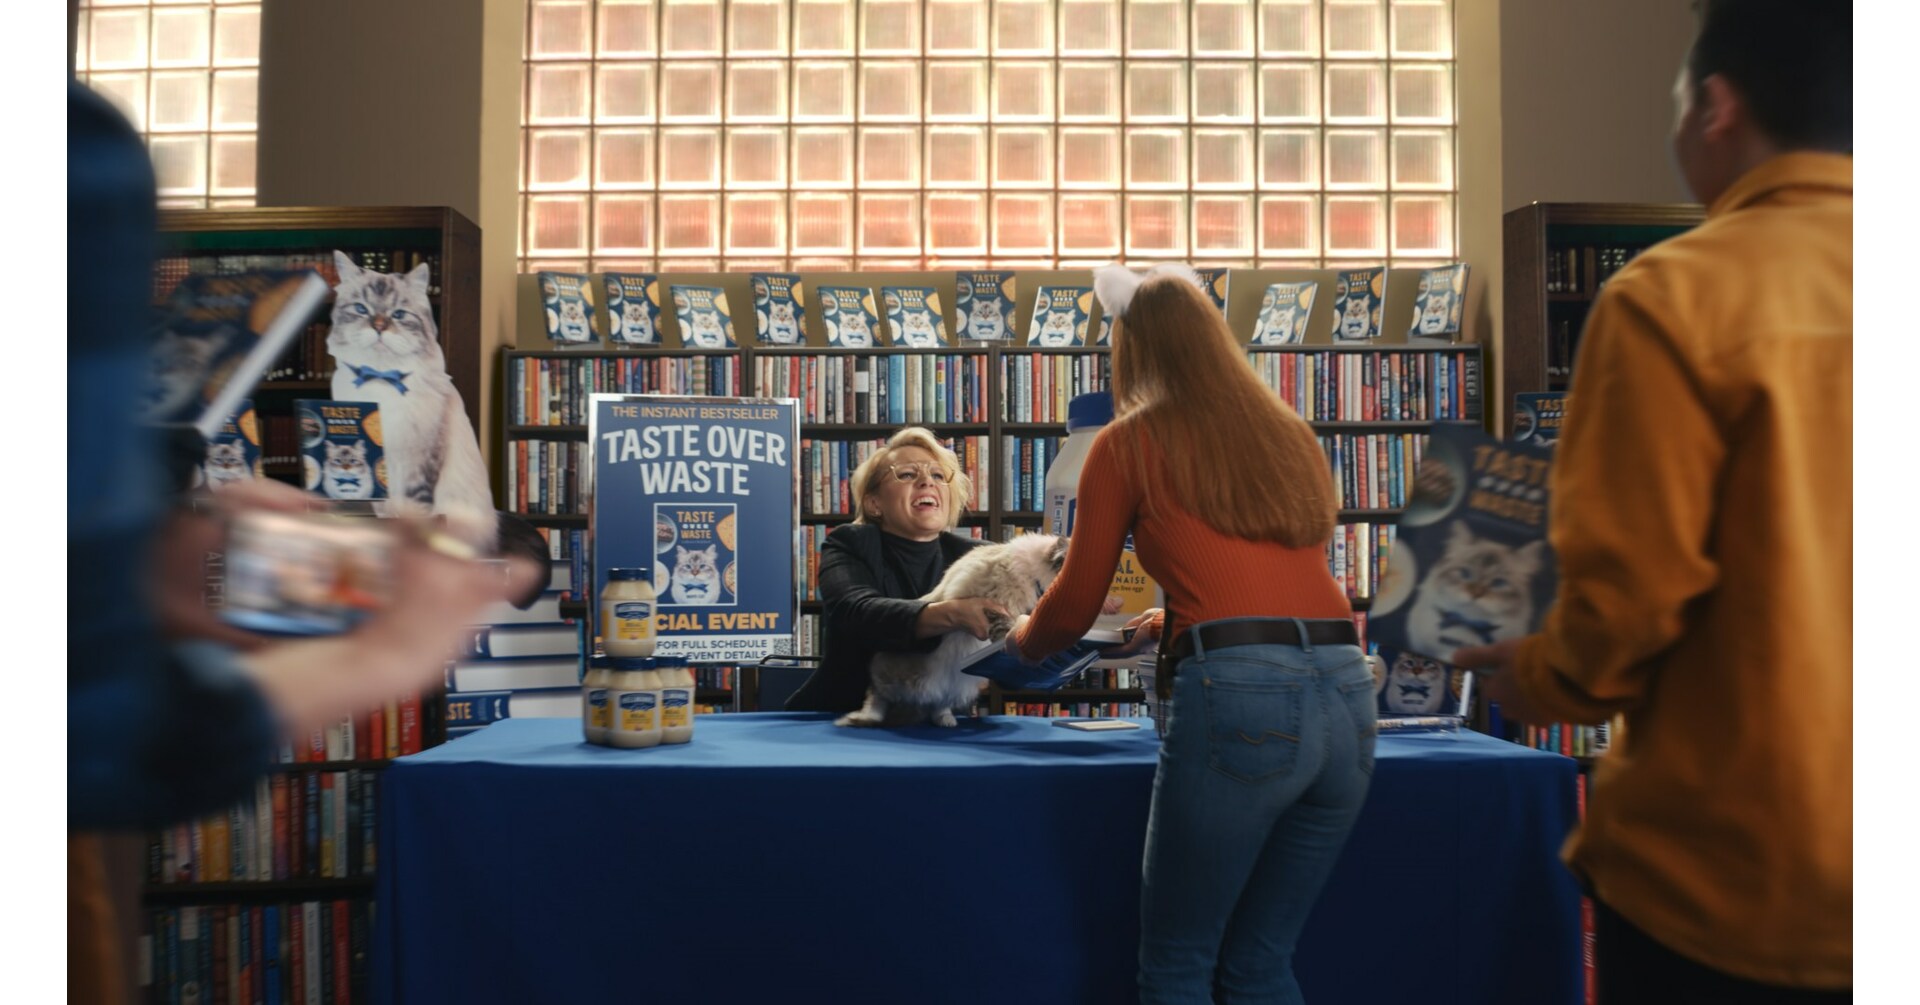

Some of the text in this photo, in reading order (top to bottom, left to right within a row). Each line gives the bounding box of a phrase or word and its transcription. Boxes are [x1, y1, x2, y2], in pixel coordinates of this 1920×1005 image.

[972, 274, 1001, 283] TASTE
[1466, 360, 1477, 396] SLEEP
[611, 406, 779, 420] THE INSTANT BESTSELLER
[602, 424, 787, 467] TASTE OVER
[640, 460, 750, 496] WASTE
[676, 511, 715, 523] TASTE
[681, 530, 712, 539] WASTE
[1116, 559, 1134, 574] AL
[1115, 576, 1146, 585] NAISE
[656, 612, 779, 631] CIAL EVENT
[657, 639, 768, 651] FOR FULL SCHEDULE
[687, 651, 719, 661] EVENT
[724, 650, 768, 661] DETAILS
[446, 702, 473, 720] STE
